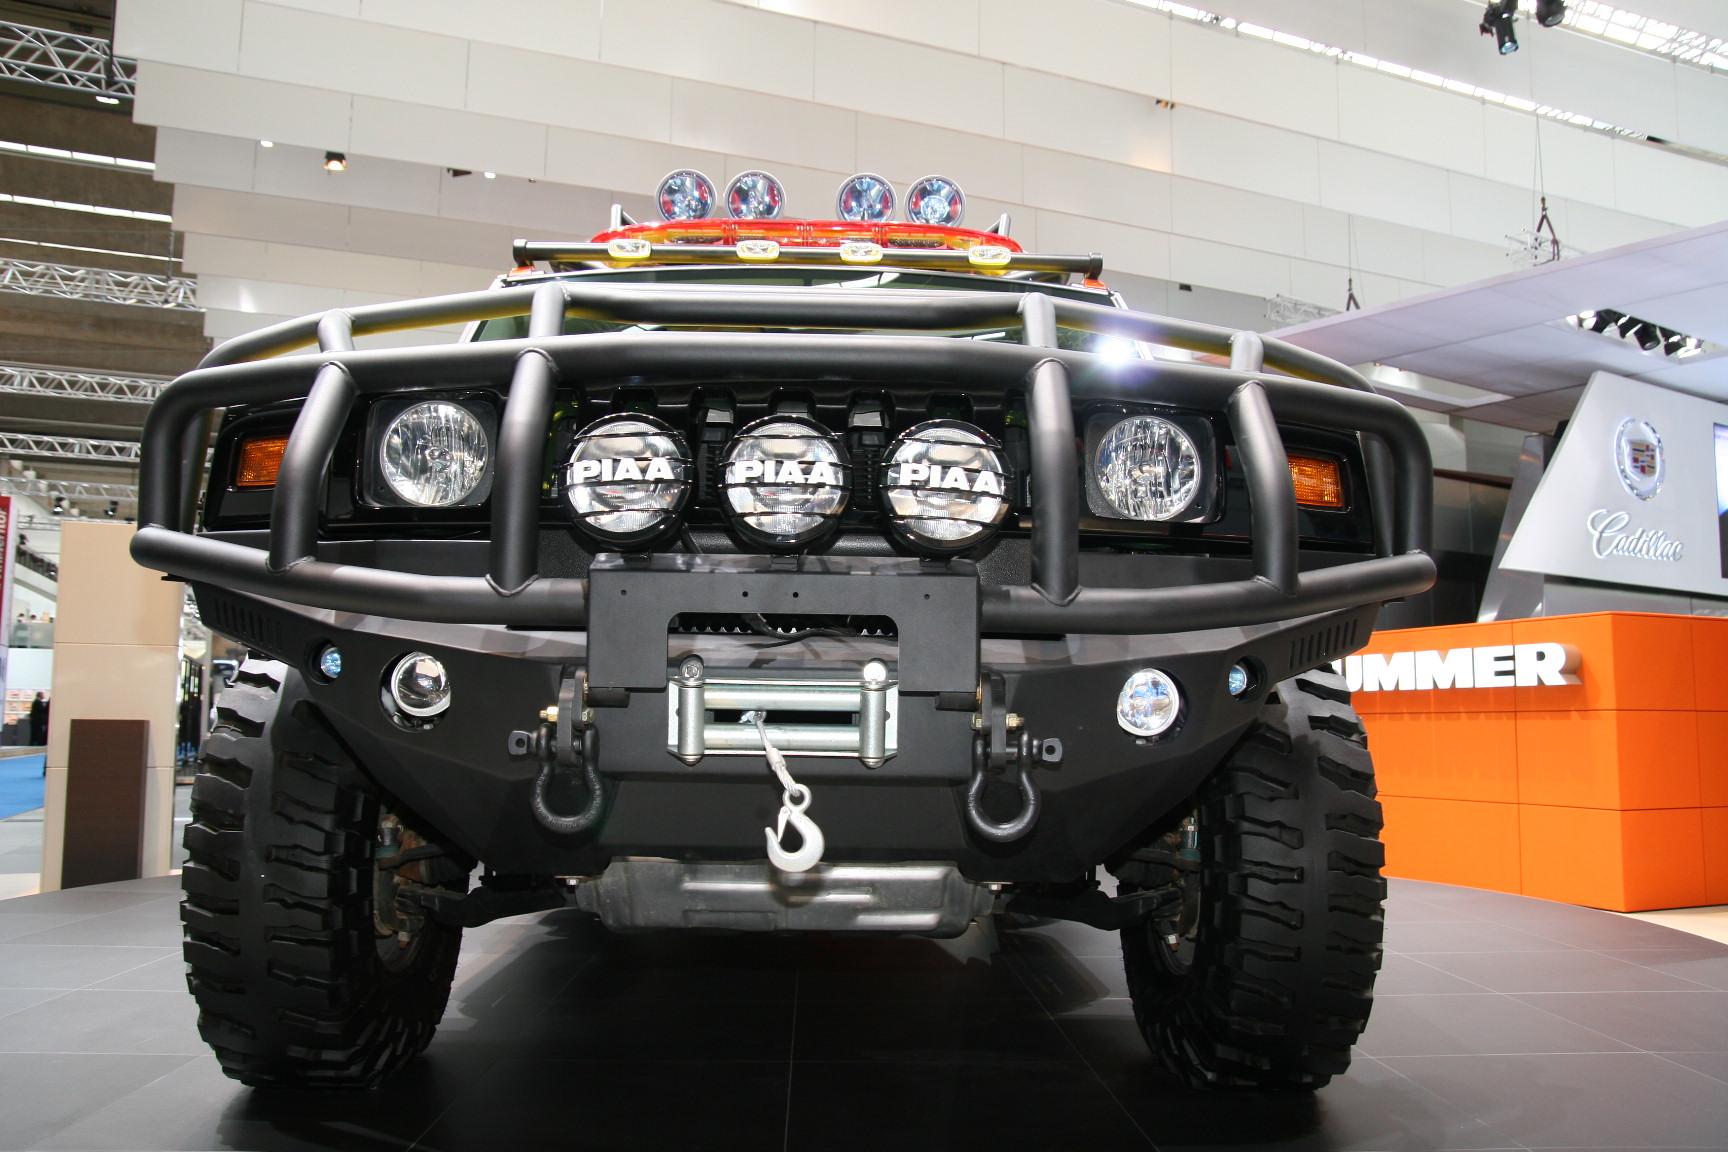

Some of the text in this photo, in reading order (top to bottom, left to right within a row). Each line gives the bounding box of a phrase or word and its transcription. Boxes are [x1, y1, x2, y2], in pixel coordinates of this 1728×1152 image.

[573, 457, 675, 484] PIAA
[734, 460, 837, 485] PIAA
[899, 462, 1000, 493] PIAA
[1586, 509, 1684, 561] Cadillac
[1331, 643, 1569, 692] UMMER
